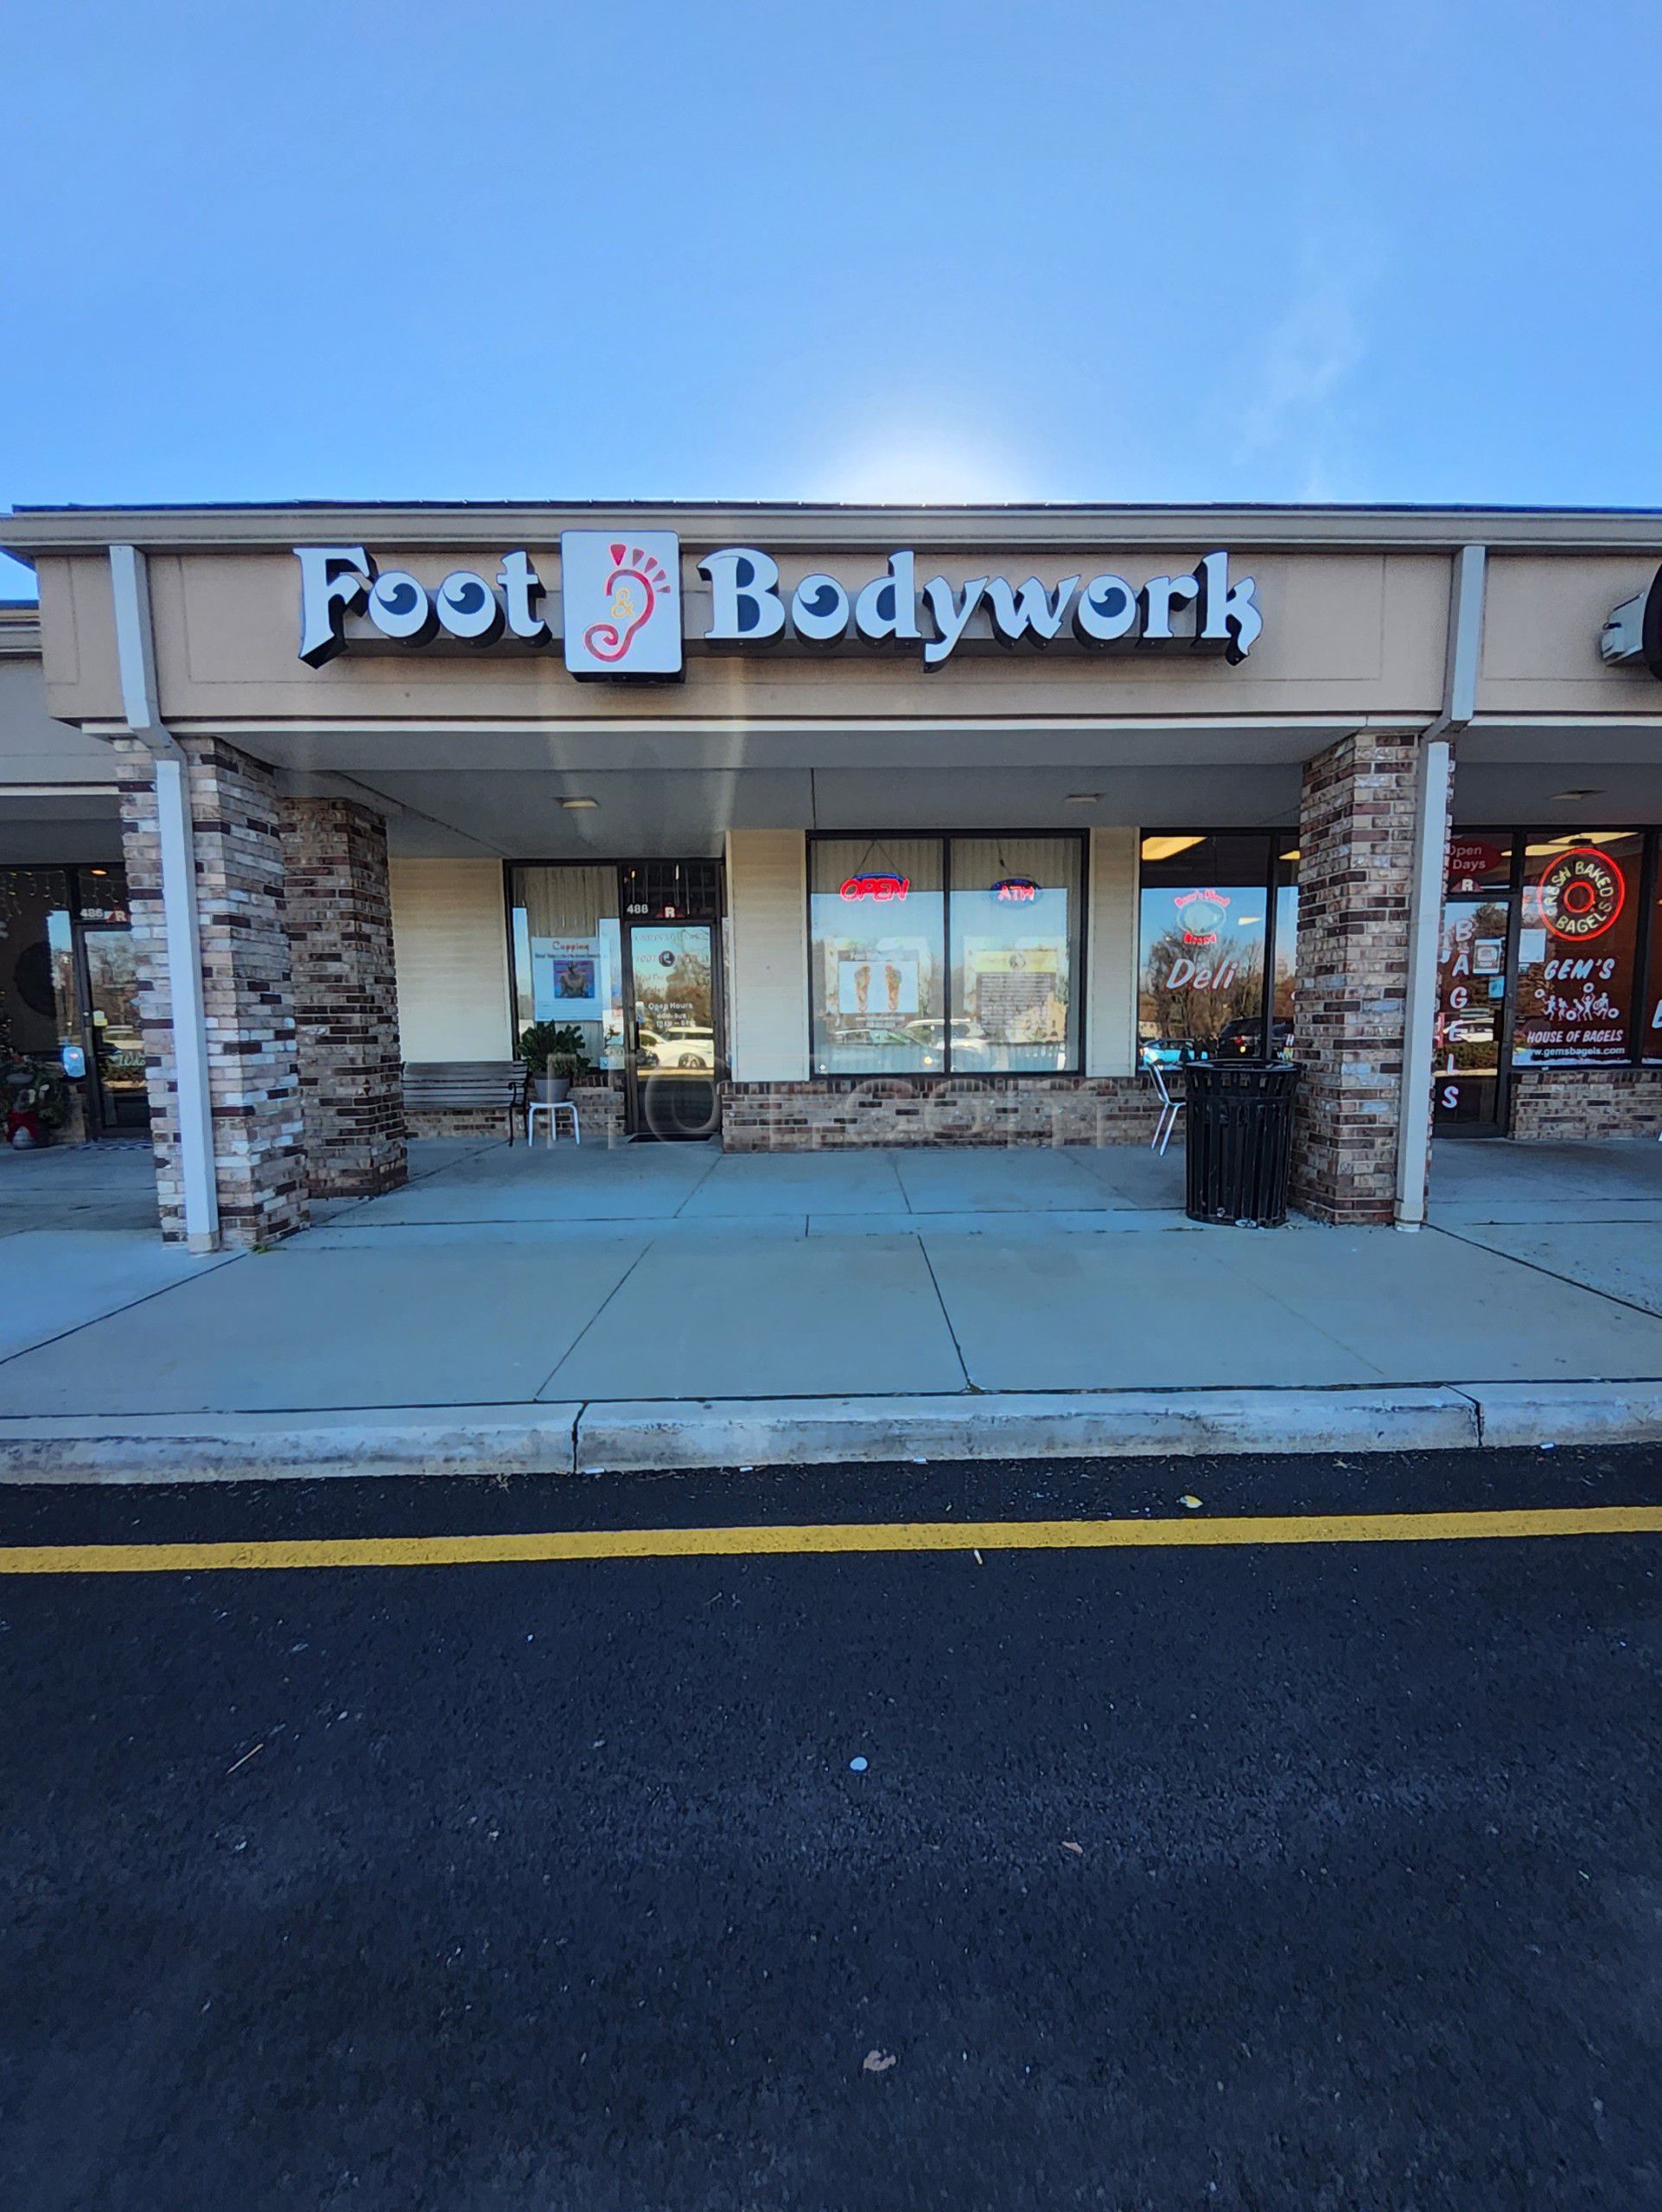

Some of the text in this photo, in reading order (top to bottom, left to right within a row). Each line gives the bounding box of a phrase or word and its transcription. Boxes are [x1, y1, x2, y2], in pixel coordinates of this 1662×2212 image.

[292, 546, 1264, 664] Foot & Bodywork
[1452, 859, 1486, 872] Days
[839, 878, 909, 901] OPEN
[1461, 878, 1474, 892] R
[1576, 861, 1614, 897] BAKED
[997, 885, 1035, 902] ATM
[1556, 902, 1613, 933] BAGELS
[1165, 957, 1240, 990] Deli
[1544, 957, 1615, 981] GEM'S
[1526, 1029, 1624, 1043] HOUSE OF BAGELS
